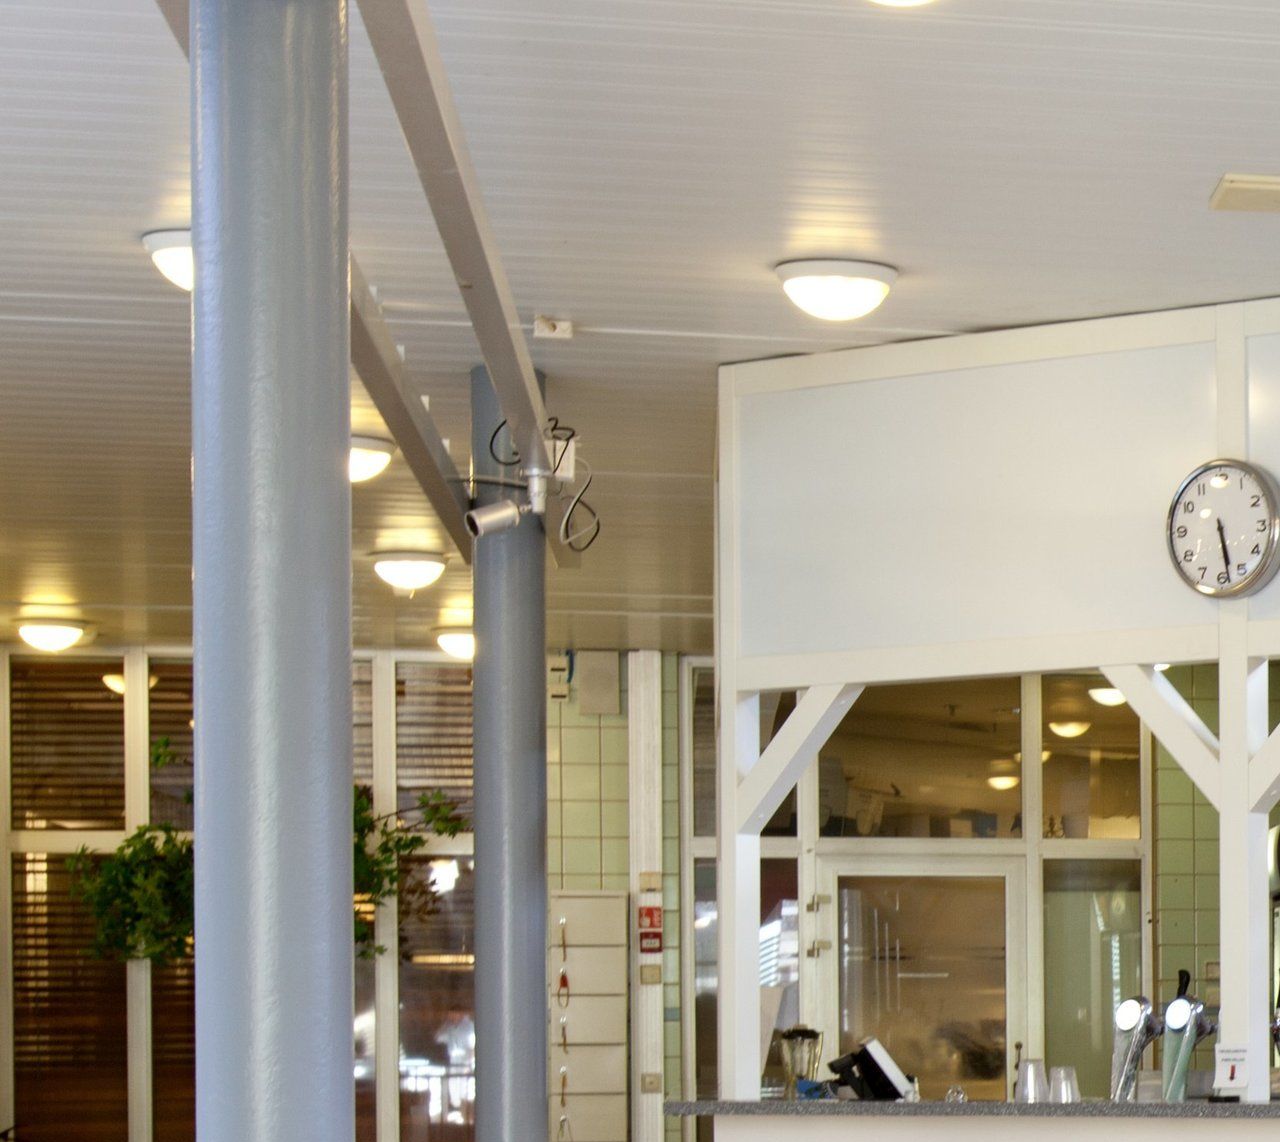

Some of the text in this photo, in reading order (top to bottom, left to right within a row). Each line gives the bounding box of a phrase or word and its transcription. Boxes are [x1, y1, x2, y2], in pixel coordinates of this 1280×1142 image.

[1197, 483, 1206, 496] 11
[1183, 499, 1195, 514] 10
[1250, 494, 1261, 508] 2
[1176, 525, 1188, 538] 9
[1256, 520, 1267, 533] 3
[1183, 549, 1194, 562] 8
[1250, 543, 1261, 556] 4
[1198, 566, 1207, 580] 7
[1236, 563, 1248, 576] 5
[1216, 571, 1228, 585] 6
